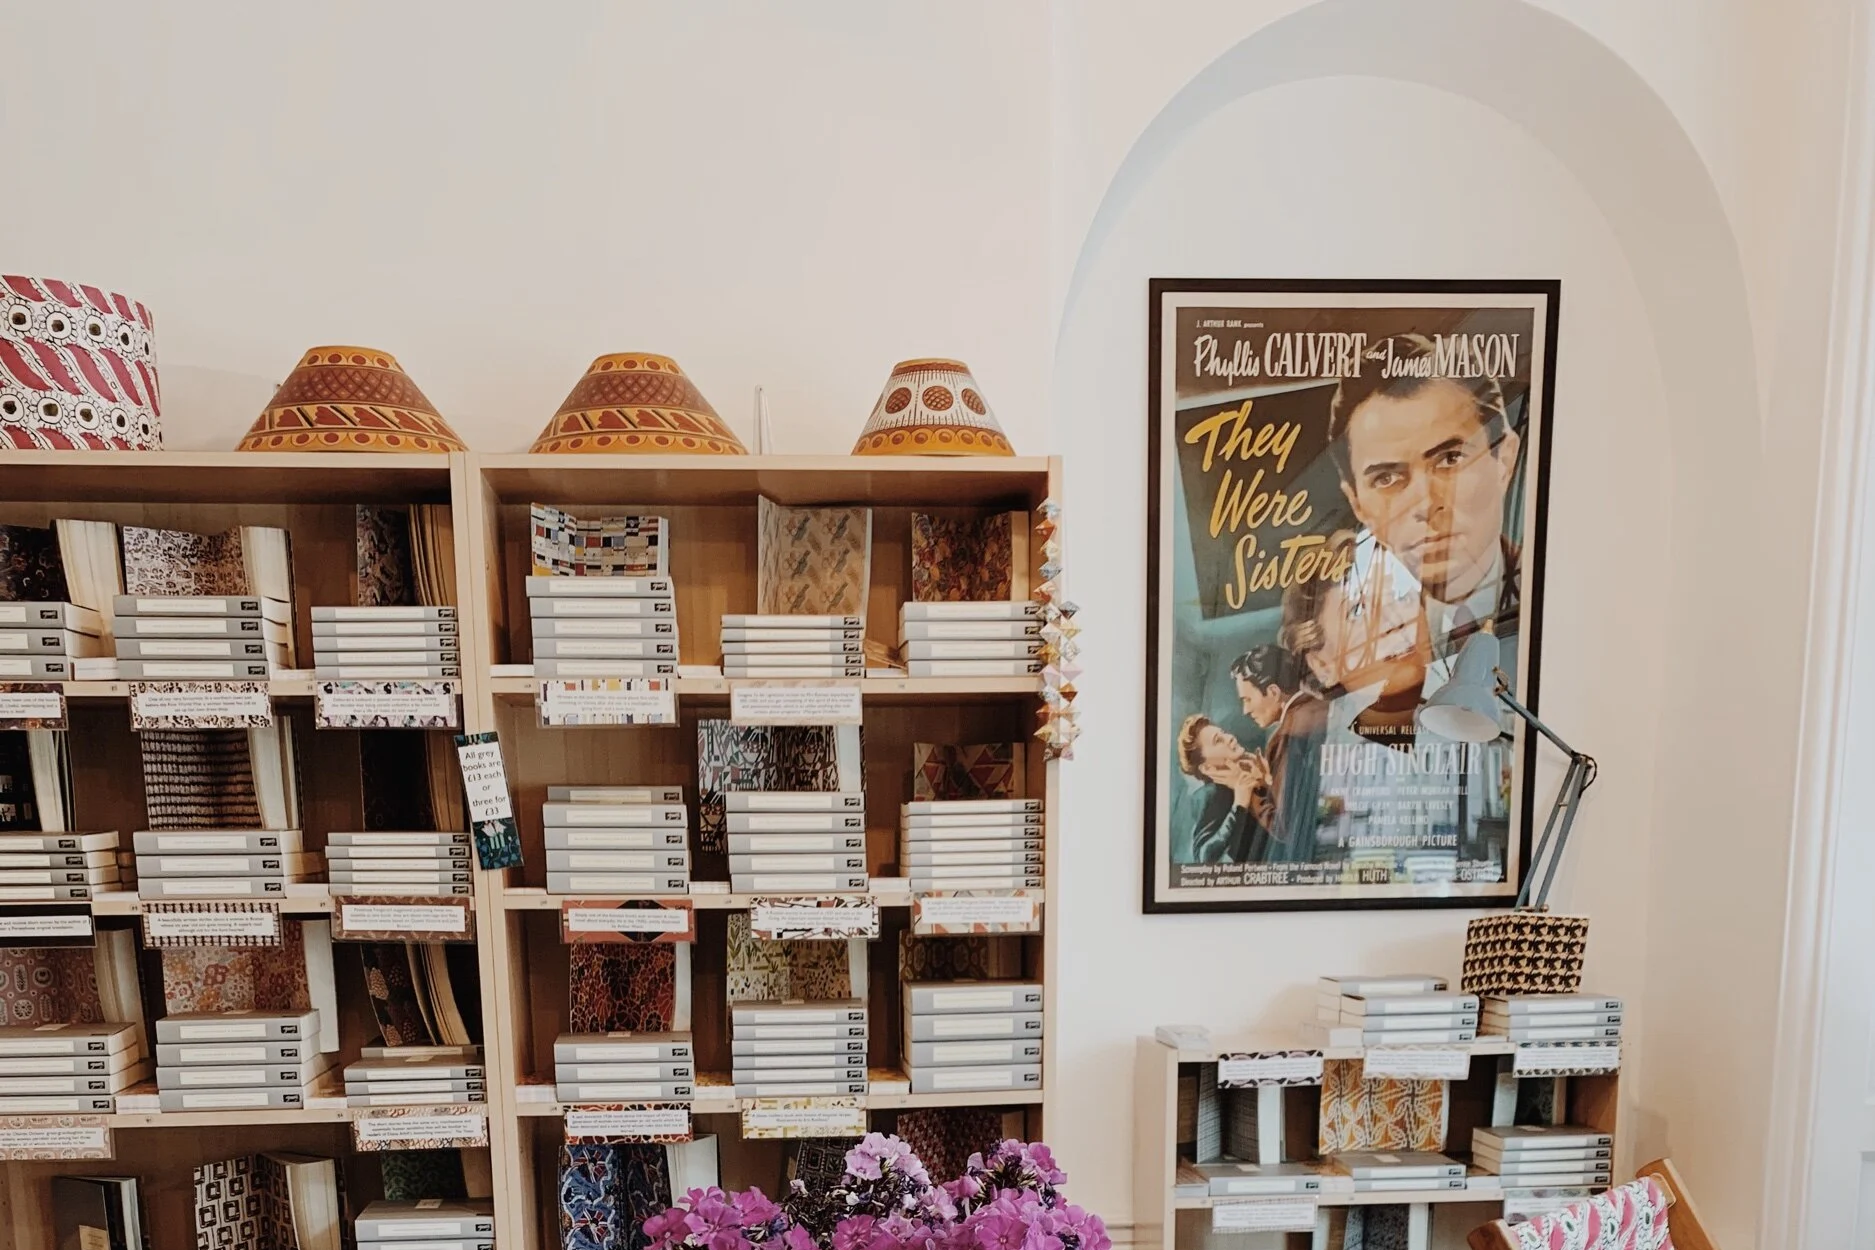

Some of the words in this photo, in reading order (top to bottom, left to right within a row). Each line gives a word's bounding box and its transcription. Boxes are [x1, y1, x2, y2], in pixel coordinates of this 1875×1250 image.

[1193, 334, 1260, 386] Phyllis
[1264, 333, 1367, 378] CALVERT
[1366, 349, 1388, 361] and
[1381, 337, 1433, 379] James
[1431, 333, 1520, 378] MASON
[1184, 400, 1301, 472] They
[1209, 470, 1313, 538] Were
[1225, 533, 1353, 609] Sisters
[1359, 725, 1397, 735] UNIVERSAL
[465, 752, 476, 760] All
[478, 751, 494, 761] grey
[1319, 743, 1377, 777] HUGH
[1386, 742, 1482, 776] SINCLAIR
[463, 762, 487, 772] books
[468, 773, 482, 782] £13
[484, 771, 502, 779] each
[472, 797, 493, 807] three
[485, 807, 499, 816] £33
[1348, 835, 1419, 848] GAINSBOROUGH
[1422, 834, 1458, 847] PICTURE
[1243, 872, 1289, 885] CRABTREE
[1362, 869, 1388, 882] HUTH
